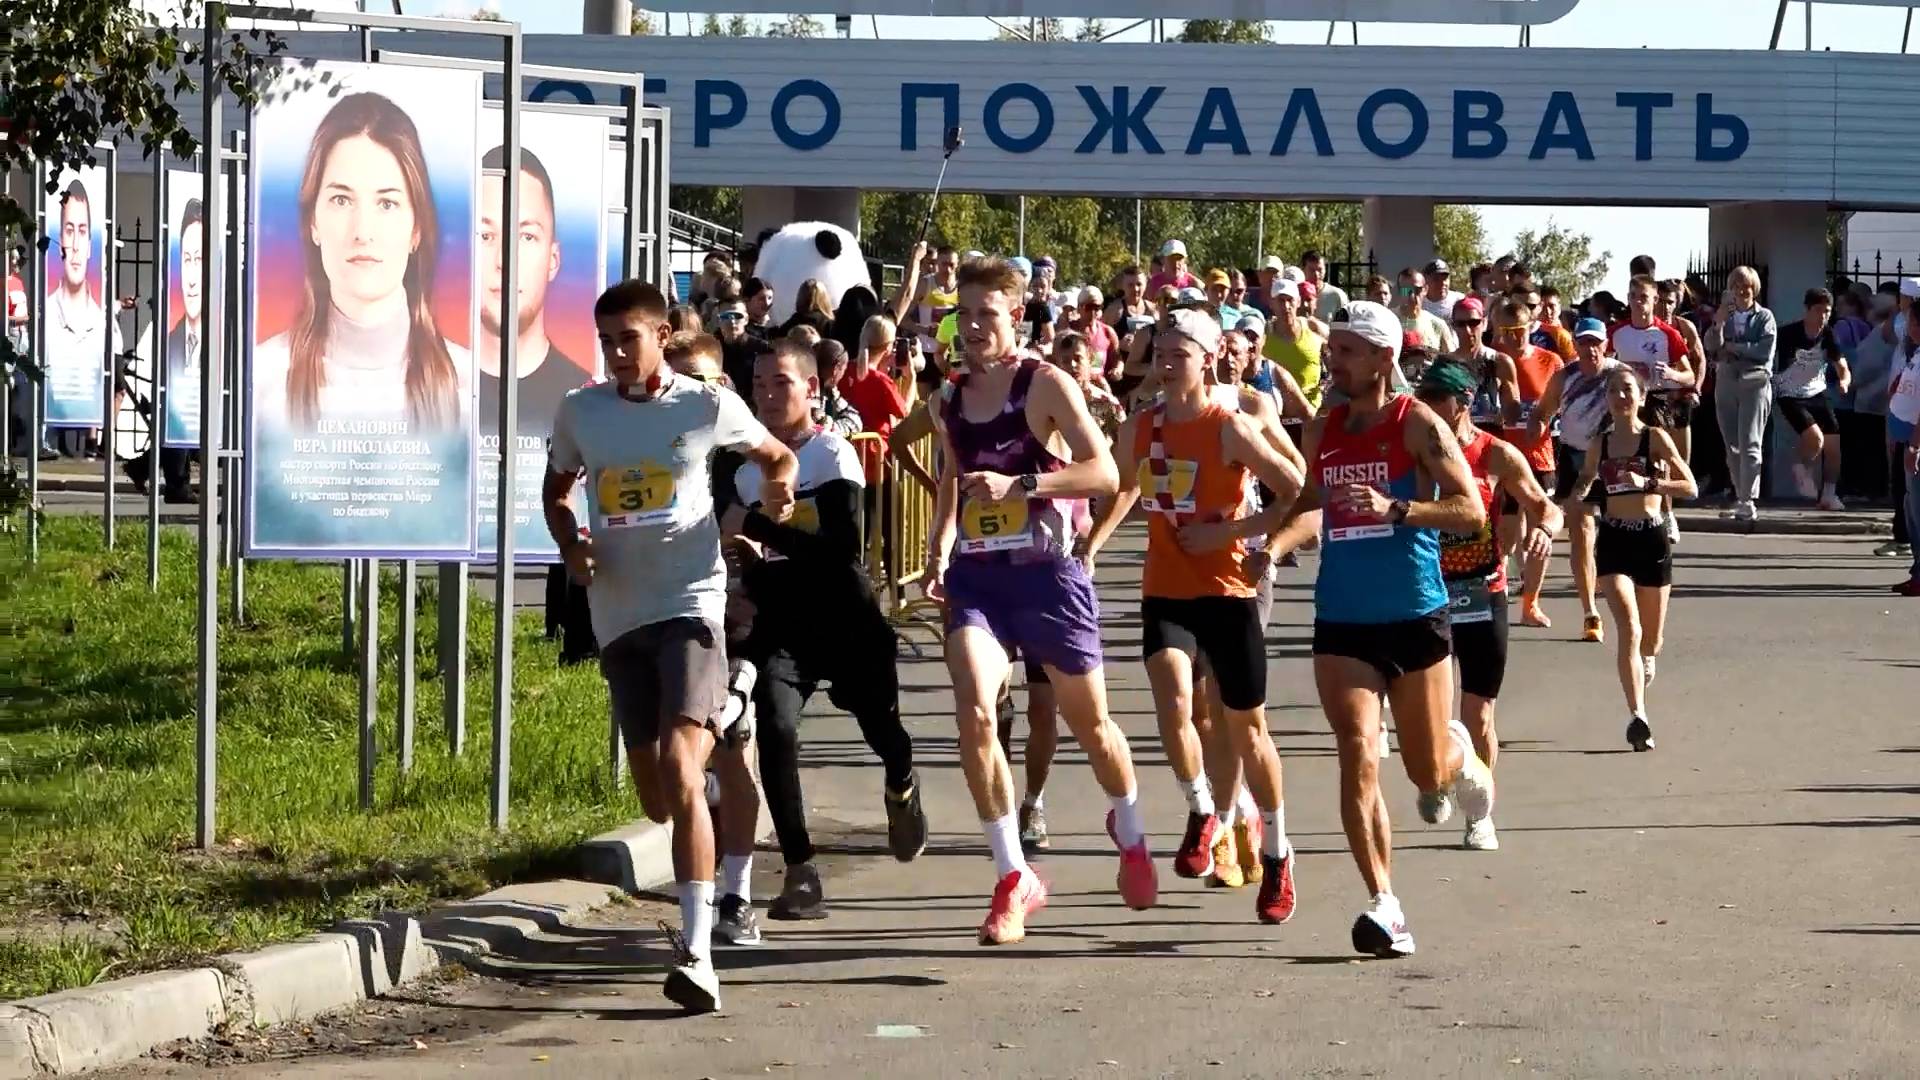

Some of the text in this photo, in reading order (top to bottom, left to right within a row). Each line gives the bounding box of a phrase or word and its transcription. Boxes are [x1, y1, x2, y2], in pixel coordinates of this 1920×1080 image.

[901, 81, 1750, 162] ПОЖАЛОВАТЬ
[293, 438, 432, 456] ВЕРА НИКОЛАЕВНА
[1322, 461, 1389, 487] RUSSIA
